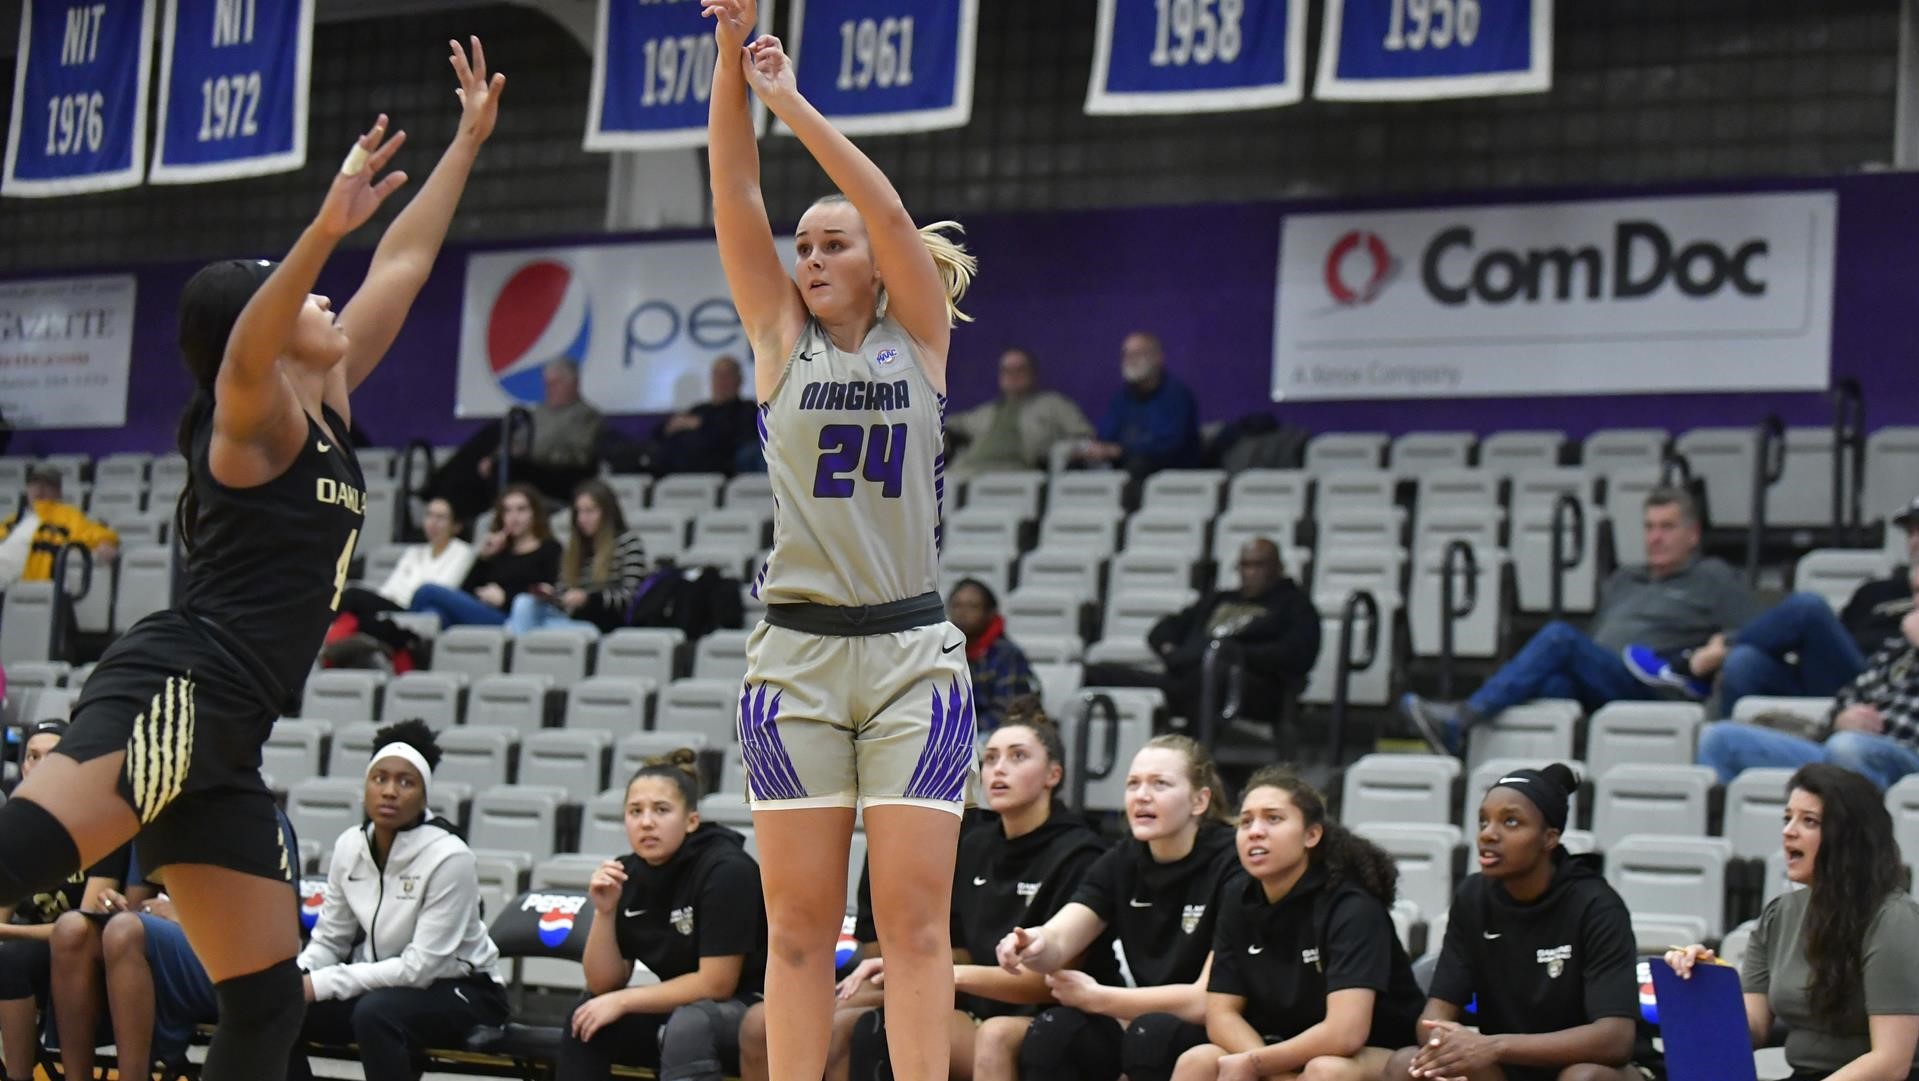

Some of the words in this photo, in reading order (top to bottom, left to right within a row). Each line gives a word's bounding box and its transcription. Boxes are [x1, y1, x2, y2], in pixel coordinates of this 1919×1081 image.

[61, 8, 106, 66] NIT
[212, 0, 256, 47] NIT
[836, 17, 914, 90] 1961
[1150, 0, 1243, 66] 1958
[641, 35, 714, 106] 1970
[46, 91, 104, 156] 1976
[198, 72, 262, 142] 1972
[1421, 218, 1770, 307] ComDoc
[624, 299, 754, 368] pe
[799, 379, 910, 411] NIAGARA
[813, 423, 907, 499] 24
[330, 528, 358, 612] 4
